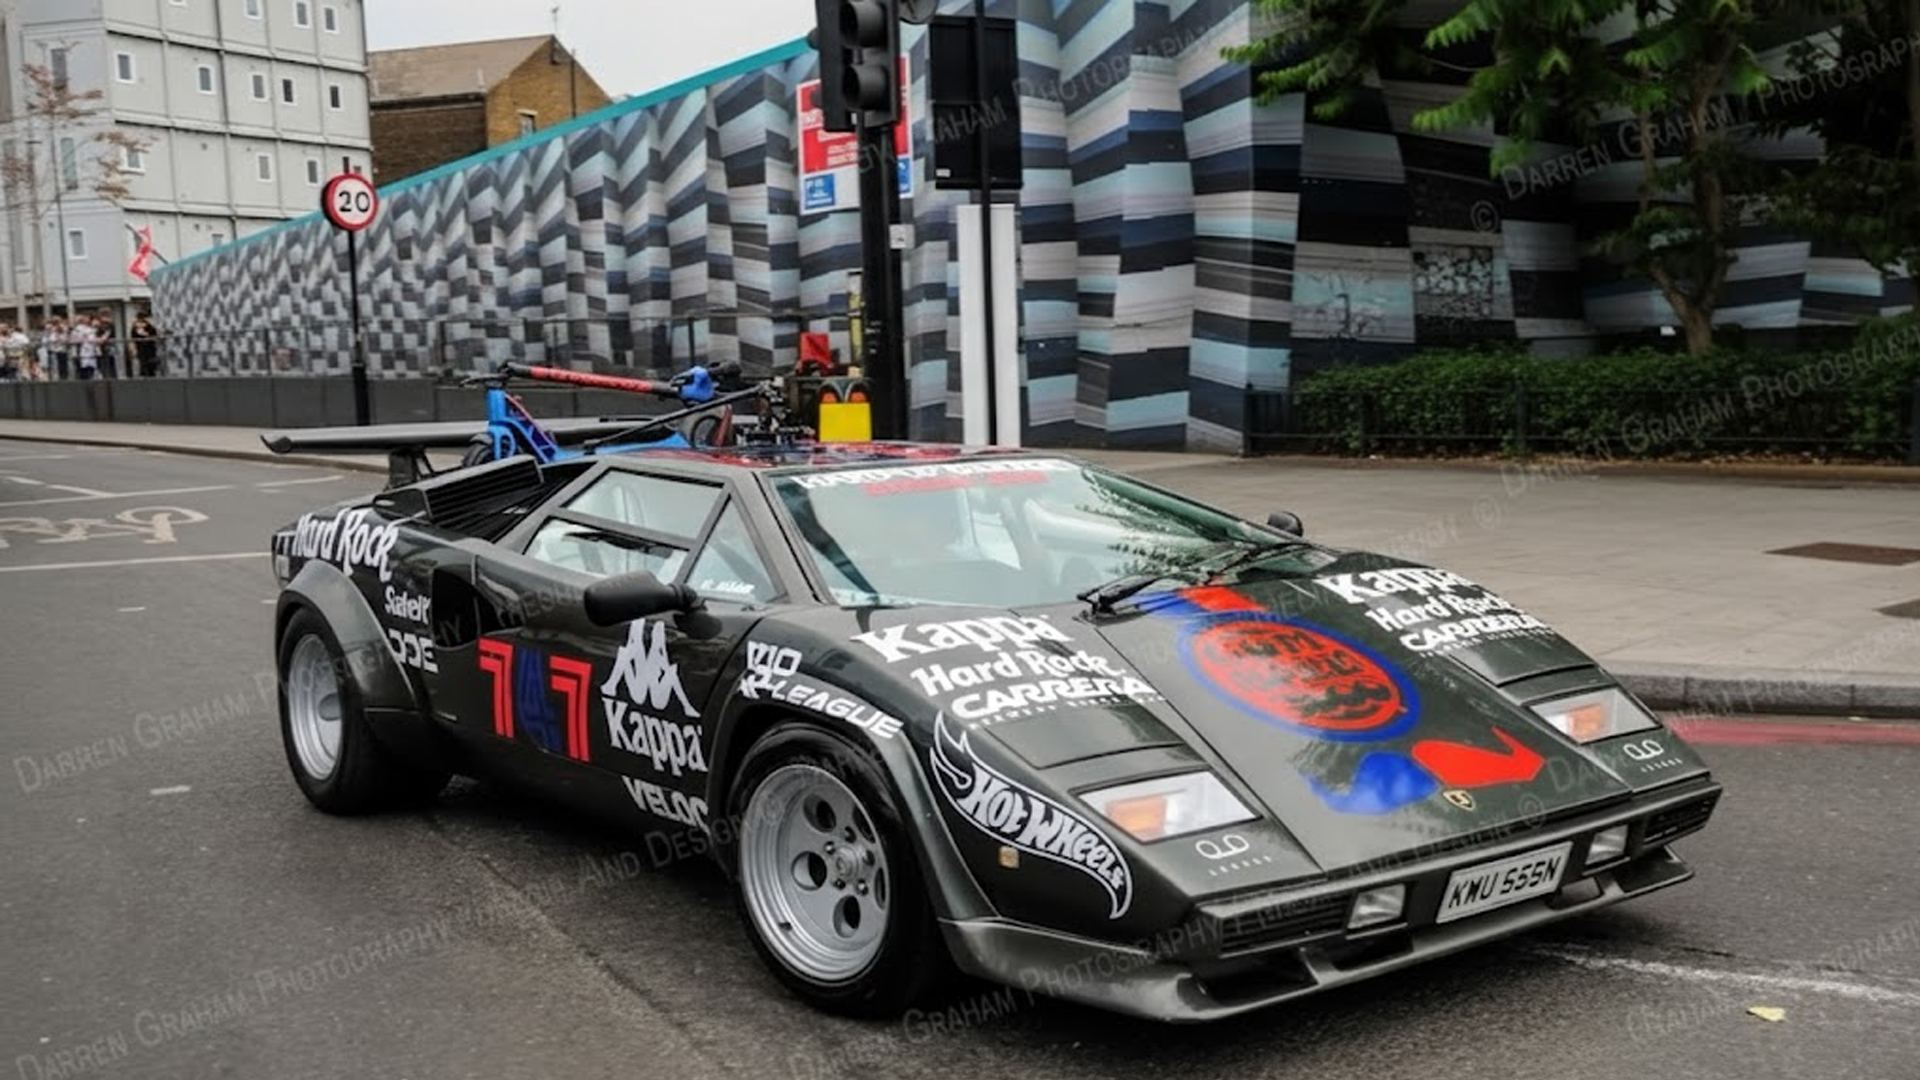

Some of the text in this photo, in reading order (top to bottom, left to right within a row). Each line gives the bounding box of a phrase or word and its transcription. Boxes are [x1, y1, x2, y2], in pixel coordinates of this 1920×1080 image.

[338, 190, 371, 213] 20
[291, 506, 399, 582] Hard Rock
[1365, 594, 1452, 632] Hard
[1399, 614, 1552, 653] CARRERA
[848, 613, 1075, 664] Kappa
[909, 649, 1128, 698] Hard Rock
[950, 675, 1160, 720] CARRERA
[601, 697, 710, 777] Kappa
[1499, 855, 1562, 896] 555N
